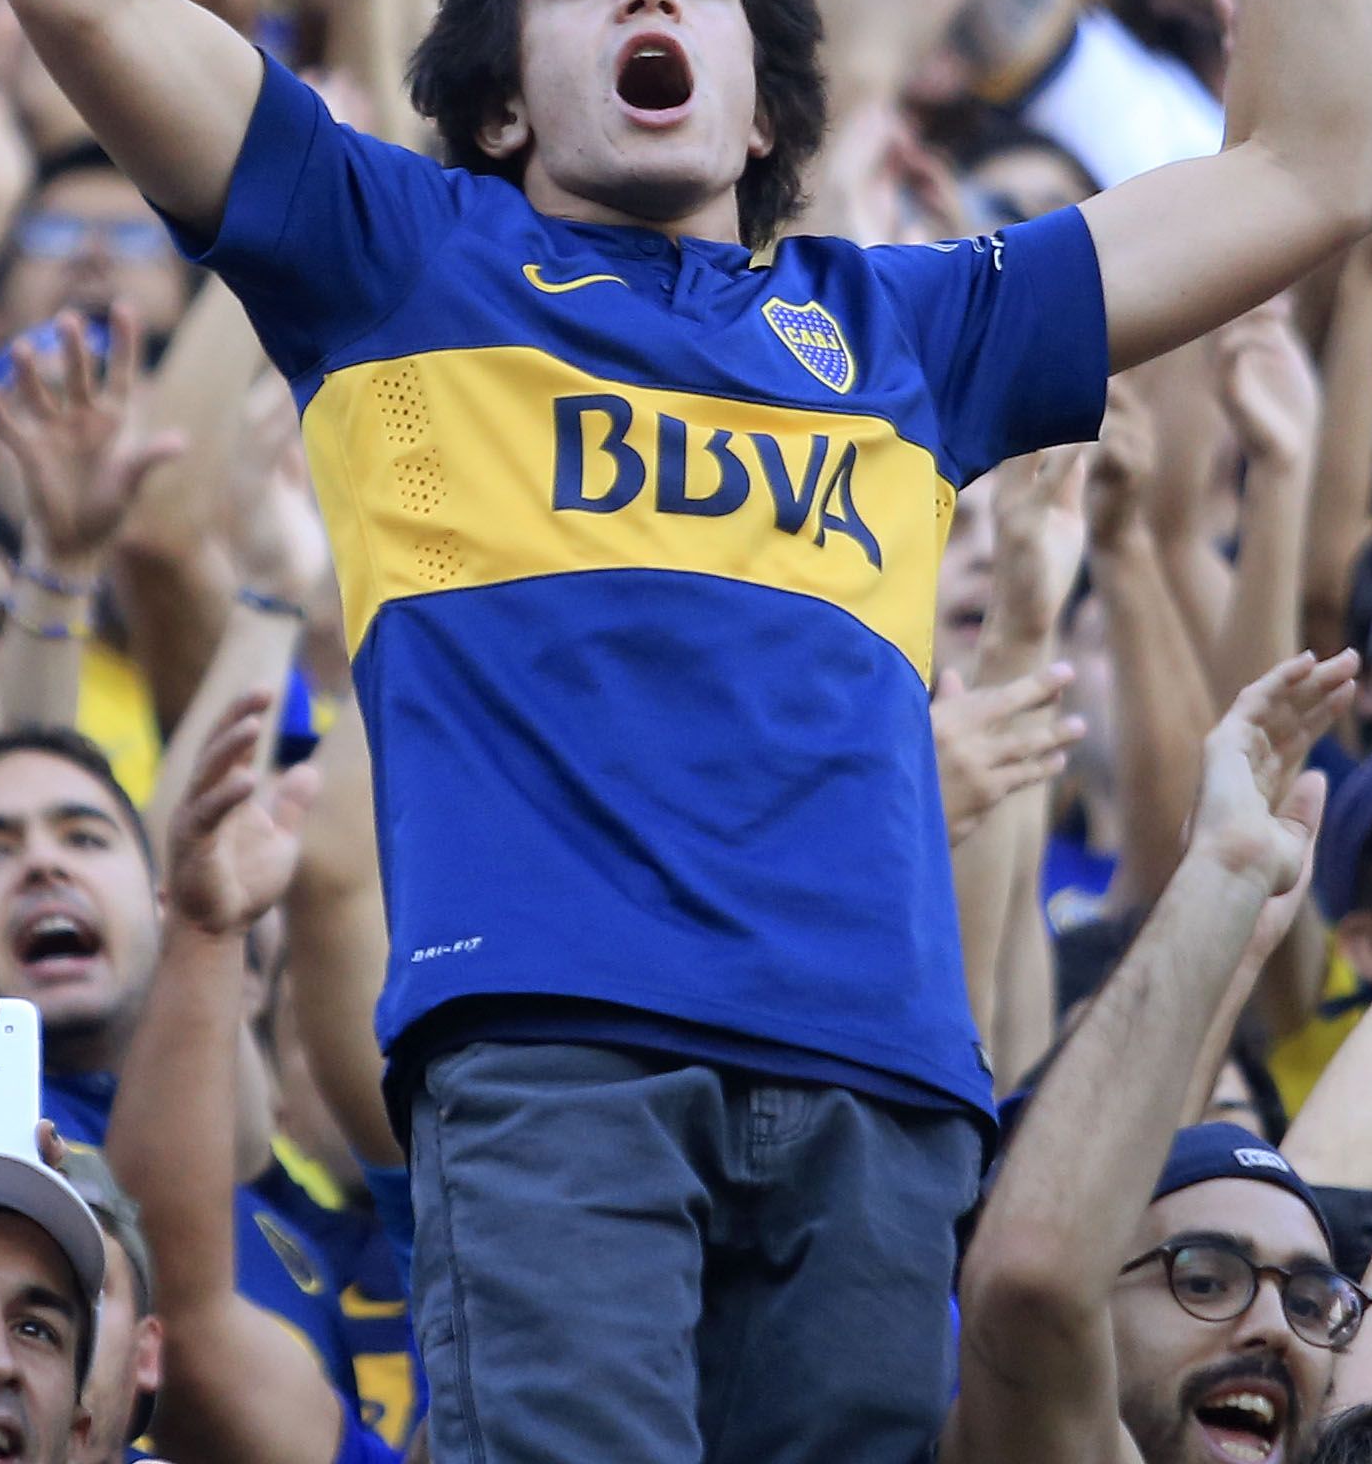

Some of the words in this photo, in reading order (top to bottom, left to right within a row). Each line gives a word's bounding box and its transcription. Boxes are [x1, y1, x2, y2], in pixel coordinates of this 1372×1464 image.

[786, 326, 841, 351] CABJ
[553, 394, 883, 572] BBVA
[411, 936, 483, 963] DRI-FIT
